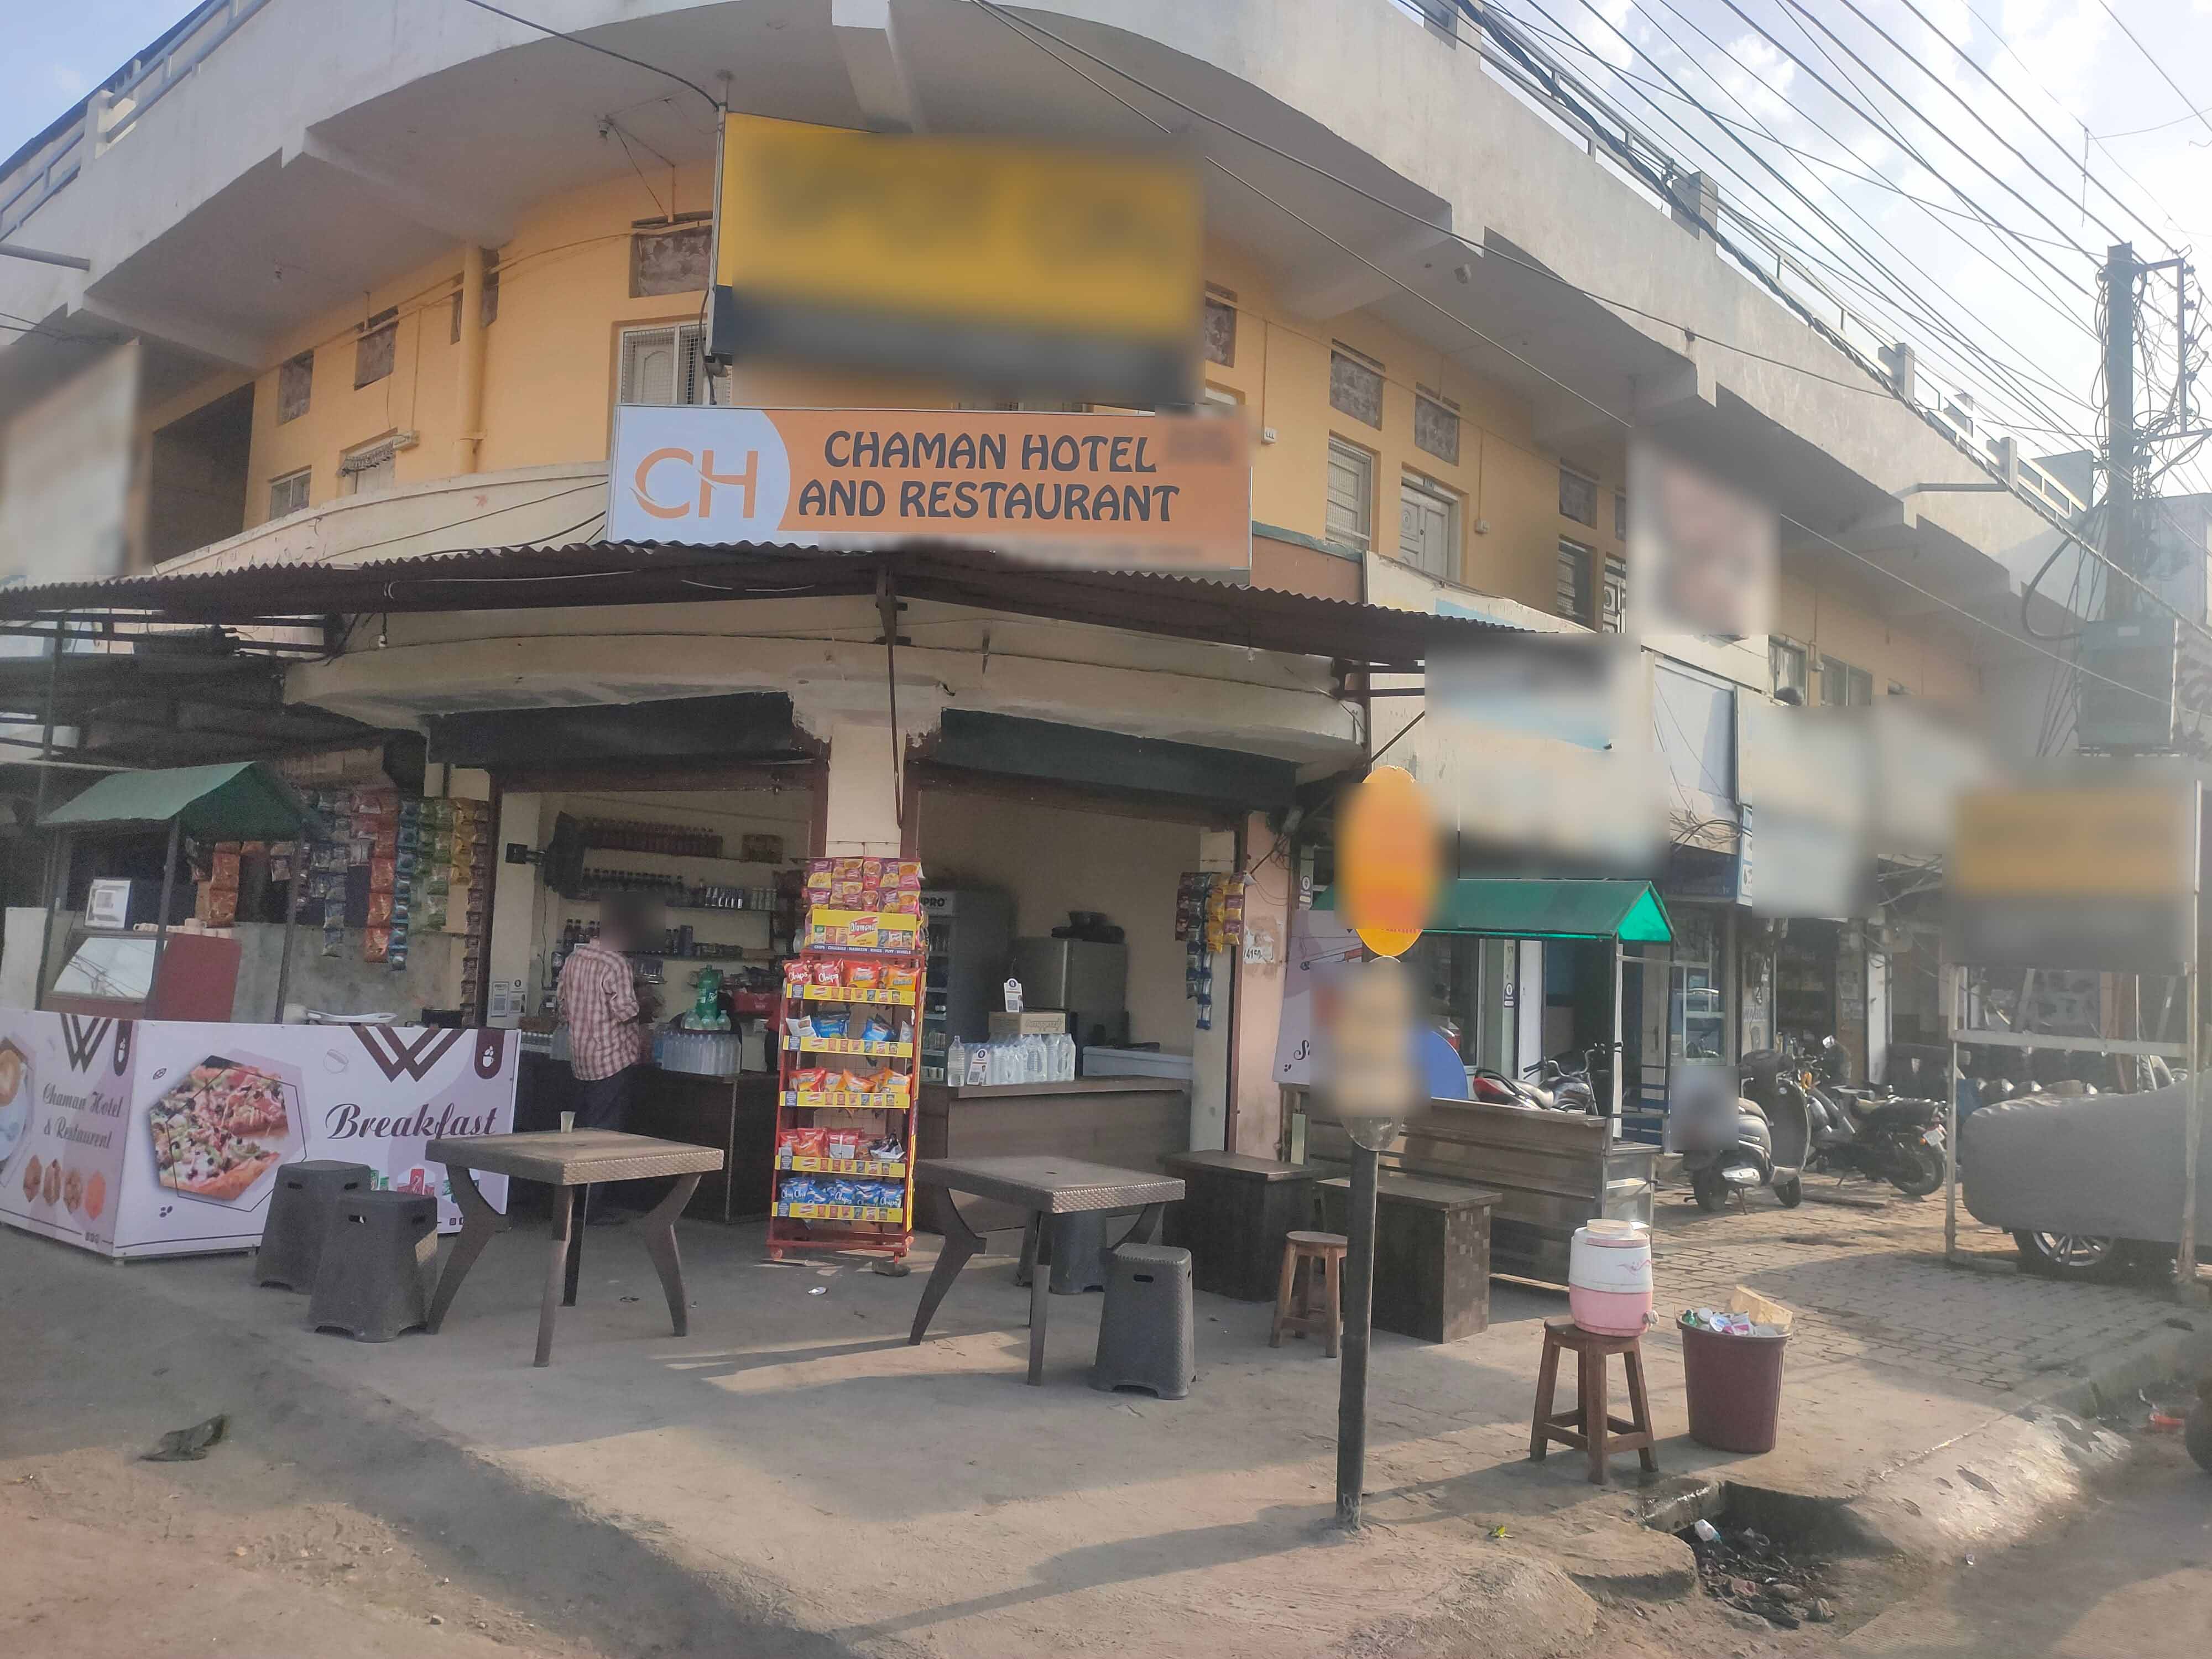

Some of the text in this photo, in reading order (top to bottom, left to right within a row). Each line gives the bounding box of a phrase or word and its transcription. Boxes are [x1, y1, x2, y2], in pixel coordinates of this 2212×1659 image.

[825, 430, 1156, 473] CHAMAN HOTEL
[630, 447, 758, 519] CH
[798, 479, 1180, 521] AND RESTAURANT
[788, 971, 808, 982] Chips
[325, 1103, 498, 1140] Breakfast
